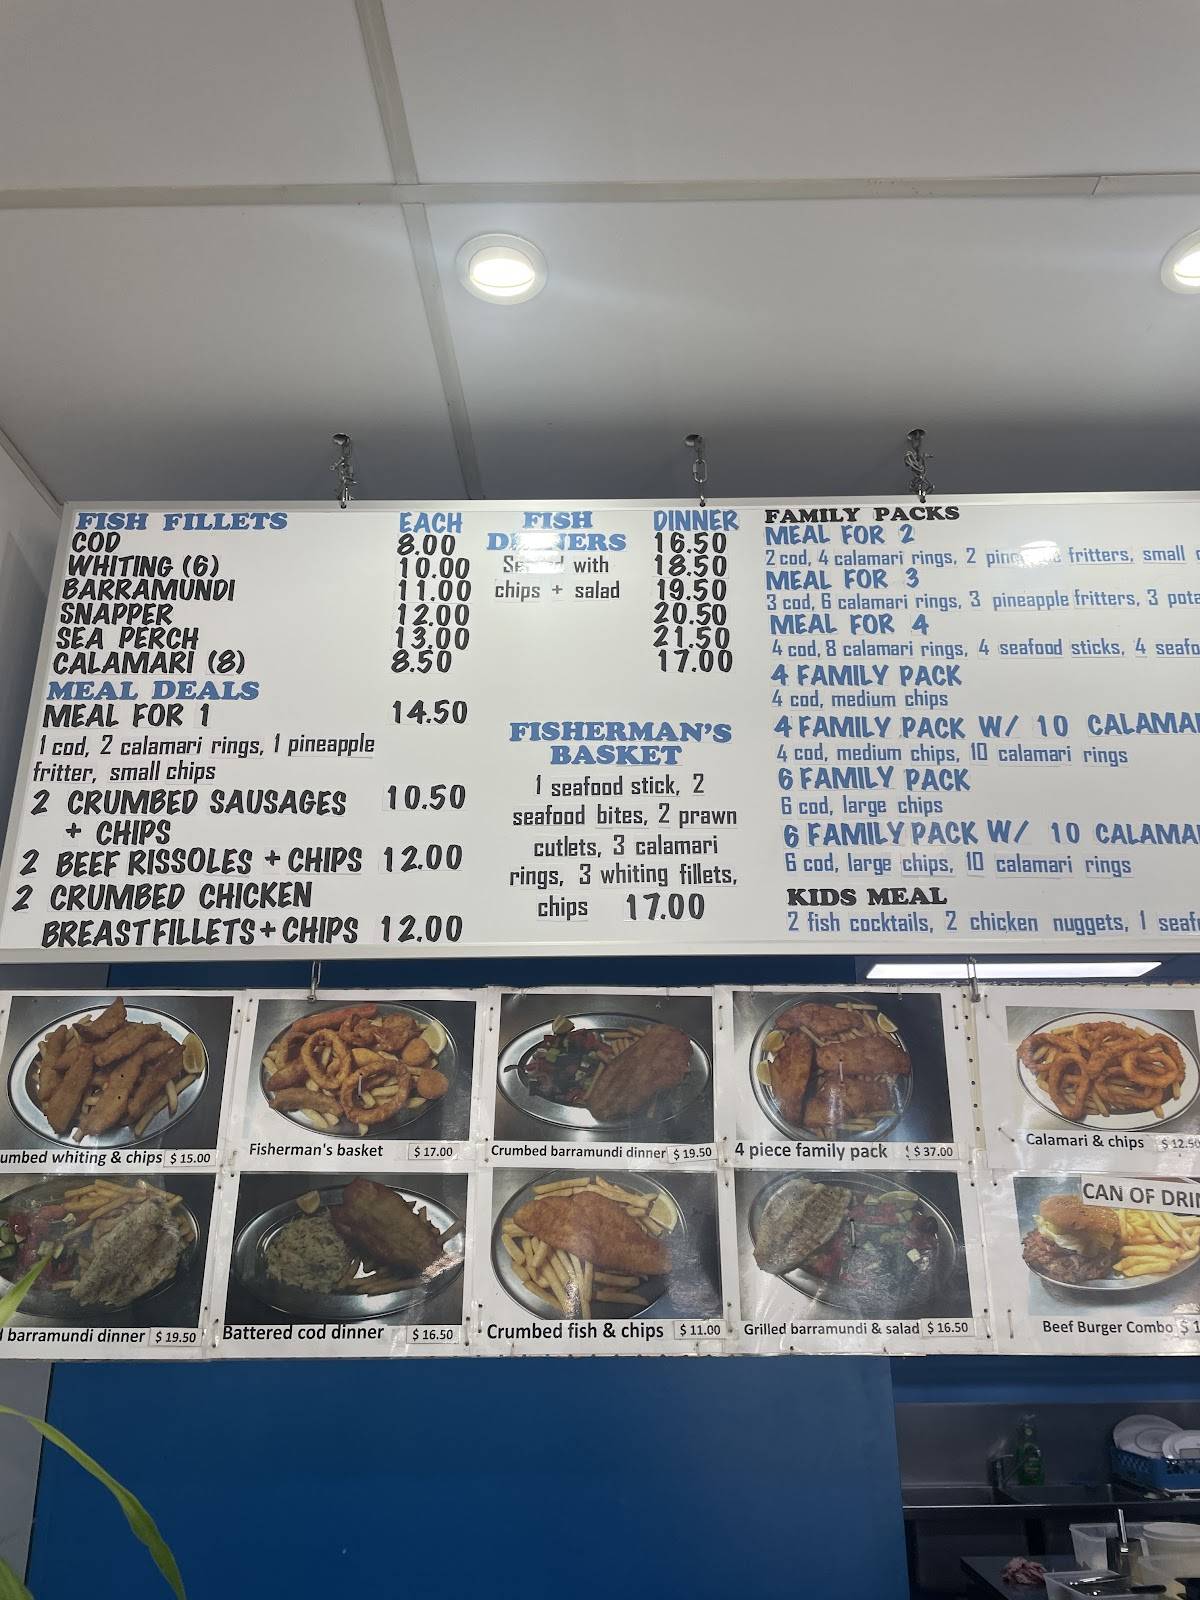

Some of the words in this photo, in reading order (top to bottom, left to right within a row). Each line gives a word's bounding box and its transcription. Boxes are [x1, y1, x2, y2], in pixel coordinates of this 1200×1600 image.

[75, 513, 148, 530] FISH
[163, 512, 288, 531] FILLETS
[399, 512, 463, 533] EACH
[523, 512, 592, 528] FISH
[654, 510, 740, 531] DINNER
[764, 508, 861, 523] FAMILY
[875, 506, 960, 521] PACKS
[71, 532, 121, 553] COD
[397, 534, 456, 555] 8.00
[654, 532, 726, 553] 16.50
[765, 525, 830, 545] MEAL
[841, 525, 885, 544] FOR
[899, 524, 915, 544] 2
[67, 555, 173, 577] WHITING
[183, 555, 219, 577] (6)
[399, 557, 470, 578] 10.00
[574, 556, 609, 573] with
[62, 580, 235, 601] BARRAMUNDI
[495, 581, 540, 602] chips
[552, 586, 563, 594] +
[575, 581, 620, 598] salad
[60, 604, 174, 625] SNAPPER
[56, 628, 104, 650] SEA
[119, 627, 199, 650] PERCH
[654, 626, 730, 649] 21.50
[52, 652, 194, 675] CALAMARI
[207, 651, 245, 674] (8)
[658, 650, 732, 672] 17.00
[47, 681, 138, 700] MEAL
[154, 681, 260, 699] DEALS
[773, 690, 782, 706] 4
[790, 692, 823, 709] cod,
[832, 691, 896, 707] medium
[905, 690, 948, 709] chips
[43, 705, 119, 728] MEAL
[132, 704, 183, 727] FOR
[200, 704, 209, 727] 1
[393, 701, 468, 724] 14.50
[510, 722, 732, 743] FISHERMAN'S
[40, 736, 45, 755] 1
[52, 736, 90, 758] cod,
[100, 736, 113, 754] 2
[121, 736, 201, 755] calamari
[211, 736, 264, 758] rings,
[274, 735, 280, 753] 1
[288, 734, 374, 757] pineapple
[550, 745, 682, 765] BASKET
[777, 744, 787, 761] 4
[795, 744, 828, 762] cod,
[837, 744, 901, 762] medium
[911, 743, 960, 763] chips,
[971, 743, 988, 761] 10
[999, 744, 1071, 763] calamari
[1083, 747, 1128, 764] rings
[33, 764, 96, 783] fritter,
[110, 761, 159, 781] small
[166, 761, 216, 783] chips
[778, 768, 793, 790] 6
[801, 766, 894, 789] FAMILY
[905, 768, 971, 791] PACK
[536, 775, 541, 794] 1
[551, 776, 622, 796] seafood
[631, 774, 680, 796] stick,
[693, 773, 704, 793] 2
[31, 790, 50, 814] 2
[67, 790, 198, 815] CRUMBED
[210, 790, 347, 816] SAUSAGES
[387, 785, 466, 810] 10.50
[782, 798, 791, 814] 6
[799, 797, 833, 815] cod,
[843, 796, 886, 817] large
[898, 796, 943, 816] chips
[513, 805, 585, 825] seafood
[597, 804, 648, 826] bites,
[659, 803, 669, 823] 2
[679, 809, 737, 828] prawn
[534, 836, 601, 857] cutlets,
[614, 835, 624, 854] 3
[636, 834, 718, 855] calamari
[20, 850, 39, 875] 2
[56, 851, 120, 877] BEEF
[127, 849, 252, 875] RISSOLES
[265, 850, 281, 866] +
[288, 848, 362, 872] CHIPS
[384, 845, 462, 872] 12.00
[510, 866, 564, 889] rings,
[580, 864, 591, 884] 3
[600, 863, 668, 886] whiting
[680, 863, 737, 885] fillets,
[11, 885, 33, 911] 2
[51, 885, 185, 911] CRUMBED
[199, 882, 312, 908] CHICKEN
[627, 892, 705, 920] 17.00
[787, 888, 856, 905] KIDS
[867, 888, 948, 905] MEAL
[538, 896, 588, 920] chips
[260, 923, 276, 938] +
[283, 917, 359, 944] CHIPS
[381, 915, 462, 942] 12.00
[788, 913, 799, 931] 2
[808, 913, 840, 931] fish
[851, 914, 934, 933] cocktails,
[945, 911, 956, 931] 2
[970, 913, 1038, 931] chicken
[1053, 915, 1128, 935] nuggets,
[1140, 911, 1146, 929] 1
[250, 1143, 333, 1158] Fisherman's
[337, 1144, 383, 1158] basket
[414, 1146, 420, 1158] $
[423, 1146, 453, 1157] 17.00
[491, 1145, 547, 1158] Crumbed
[551, 1145, 623, 1158] barramundi
[626, 1146, 666, 1158] dinner
[735, 1143, 744, 1156] 4
[749, 1144, 792, 1161] piece
[796, 1143, 846, 1161] family
[850, 1143, 888, 1161] pack
[914, 1146, 920, 1158] $
[924, 1146, 953, 1157] 37.00
[1026, 1133, 1087, 1147] Calamari
[1093, 1135, 1103, 1147] &
[1109, 1135, 1144, 1150] chips
[51, 1150, 107, 1167] whiting
[110, 1151, 123, 1164] &
[126, 1150, 162, 1167] chips
[170, 1152, 177, 1165] $
[181, 1153, 211, 1164] 15.00
[673, 1148, 679, 1161] $
[682, 1147, 712, 1158] 19.50
[1083, 1183, 1123, 1201] CAN
[1130, 1188, 1154, 1204] OF
[8, 1329, 93, 1343] barramundi
[97, 1329, 145, 1343] dinner
[155, 1331, 162, 1344] $
[166, 1331, 196, 1342] 19.50
[223, 1324, 293, 1340] Battered
[298, 1325, 326, 1340] cod
[330, 1325, 384, 1340] dinner
[413, 1328, 419, 1341] $
[423, 1329, 453, 1340] 16.50
[487, 1322, 563, 1340] Crumbed
[568, 1322, 600, 1339] fish
[603, 1322, 616, 1339] &
[621, 1321, 664, 1342] chips
[680, 1325, 686, 1337] $
[690, 1325, 720, 1336] 11.00
[743, 1322, 787, 1336] Grilled
[791, 1322, 868, 1336] barramundi
[872, 1322, 882, 1335] &
[885, 1322, 919, 1335] salad
[927, 1322, 934, 1335] $
[937, 1322, 968, 1333] 16.50
[1043, 1320, 1074, 1332] Beef
[1078, 1321, 1124, 1335] Burger
[1127, 1321, 1173, 1333] Combo
